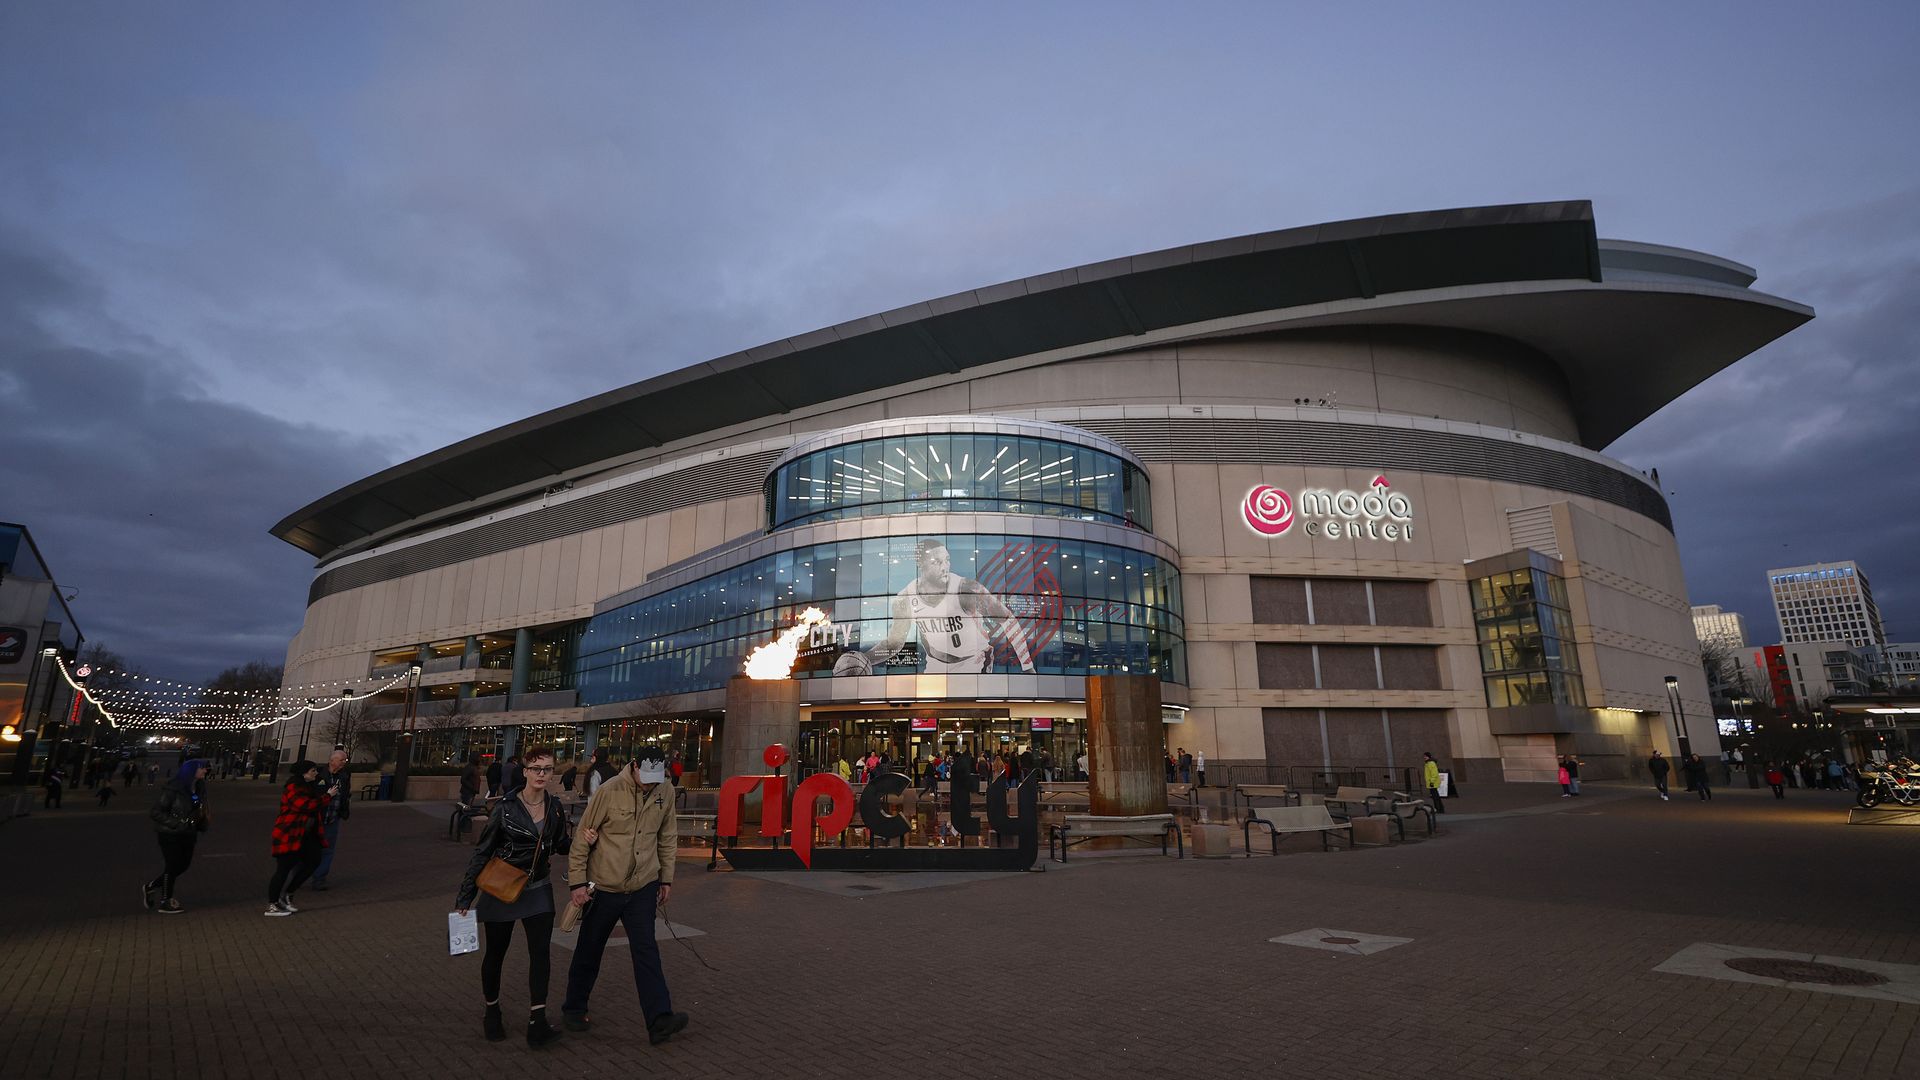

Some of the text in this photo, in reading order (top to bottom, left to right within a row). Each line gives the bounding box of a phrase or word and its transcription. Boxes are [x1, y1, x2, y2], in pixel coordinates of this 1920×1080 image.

[1302, 475, 1413, 519] moda
[1305, 519, 1413, 540] center
[916, 615, 964, 633] BLAZERS
[810, 623, 853, 648] CITY
[951, 633, 962, 648] 0
